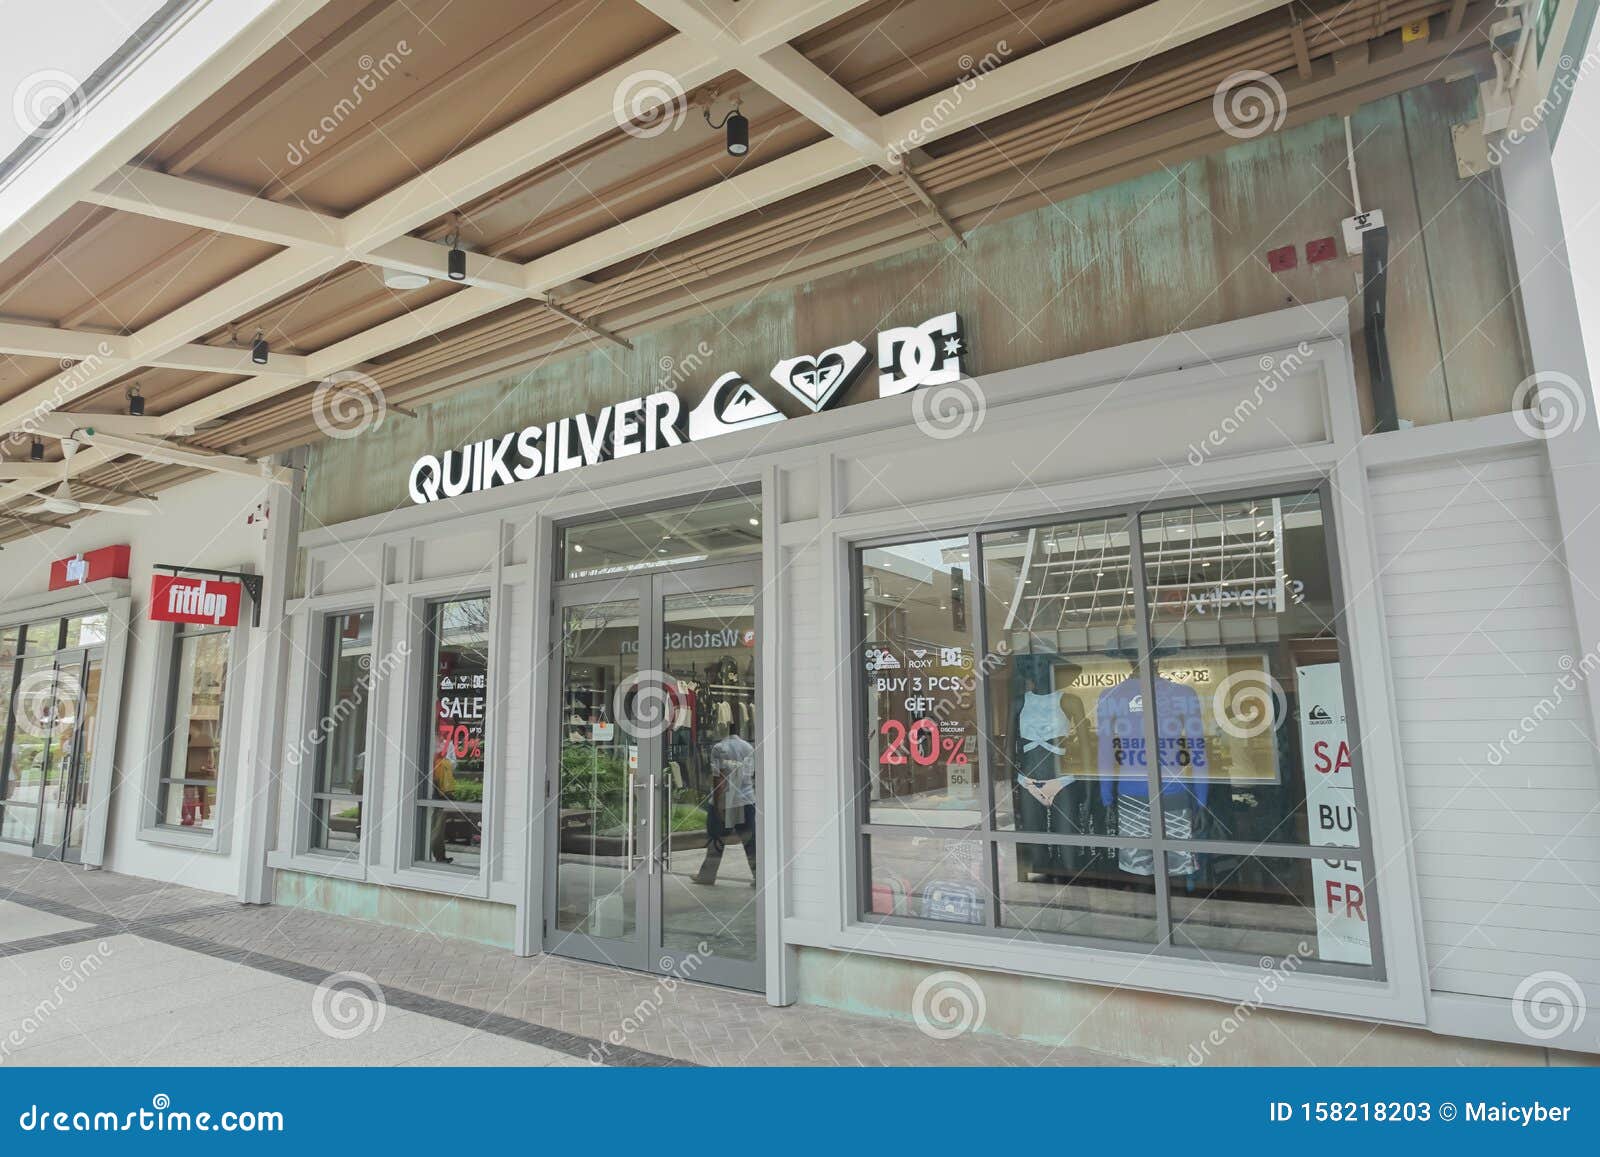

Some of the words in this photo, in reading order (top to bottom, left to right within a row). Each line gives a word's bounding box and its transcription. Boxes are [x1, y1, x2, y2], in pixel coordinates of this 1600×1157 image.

[878, 311, 962, 398] DC
[408, 391, 683, 504] QUIKSILVER
[168, 580, 228, 625] fitflop
[908, 660, 933, 669] ROXY
[877, 678, 908, 691] BUY
[912, 678, 922, 691] 3
[928, 677, 964, 691] PCS.
[440, 697, 483, 719] SALE
[904, 697, 935, 711] GET
[439, 724, 481, 758] 70%
[879, 719, 969, 766] 20%
